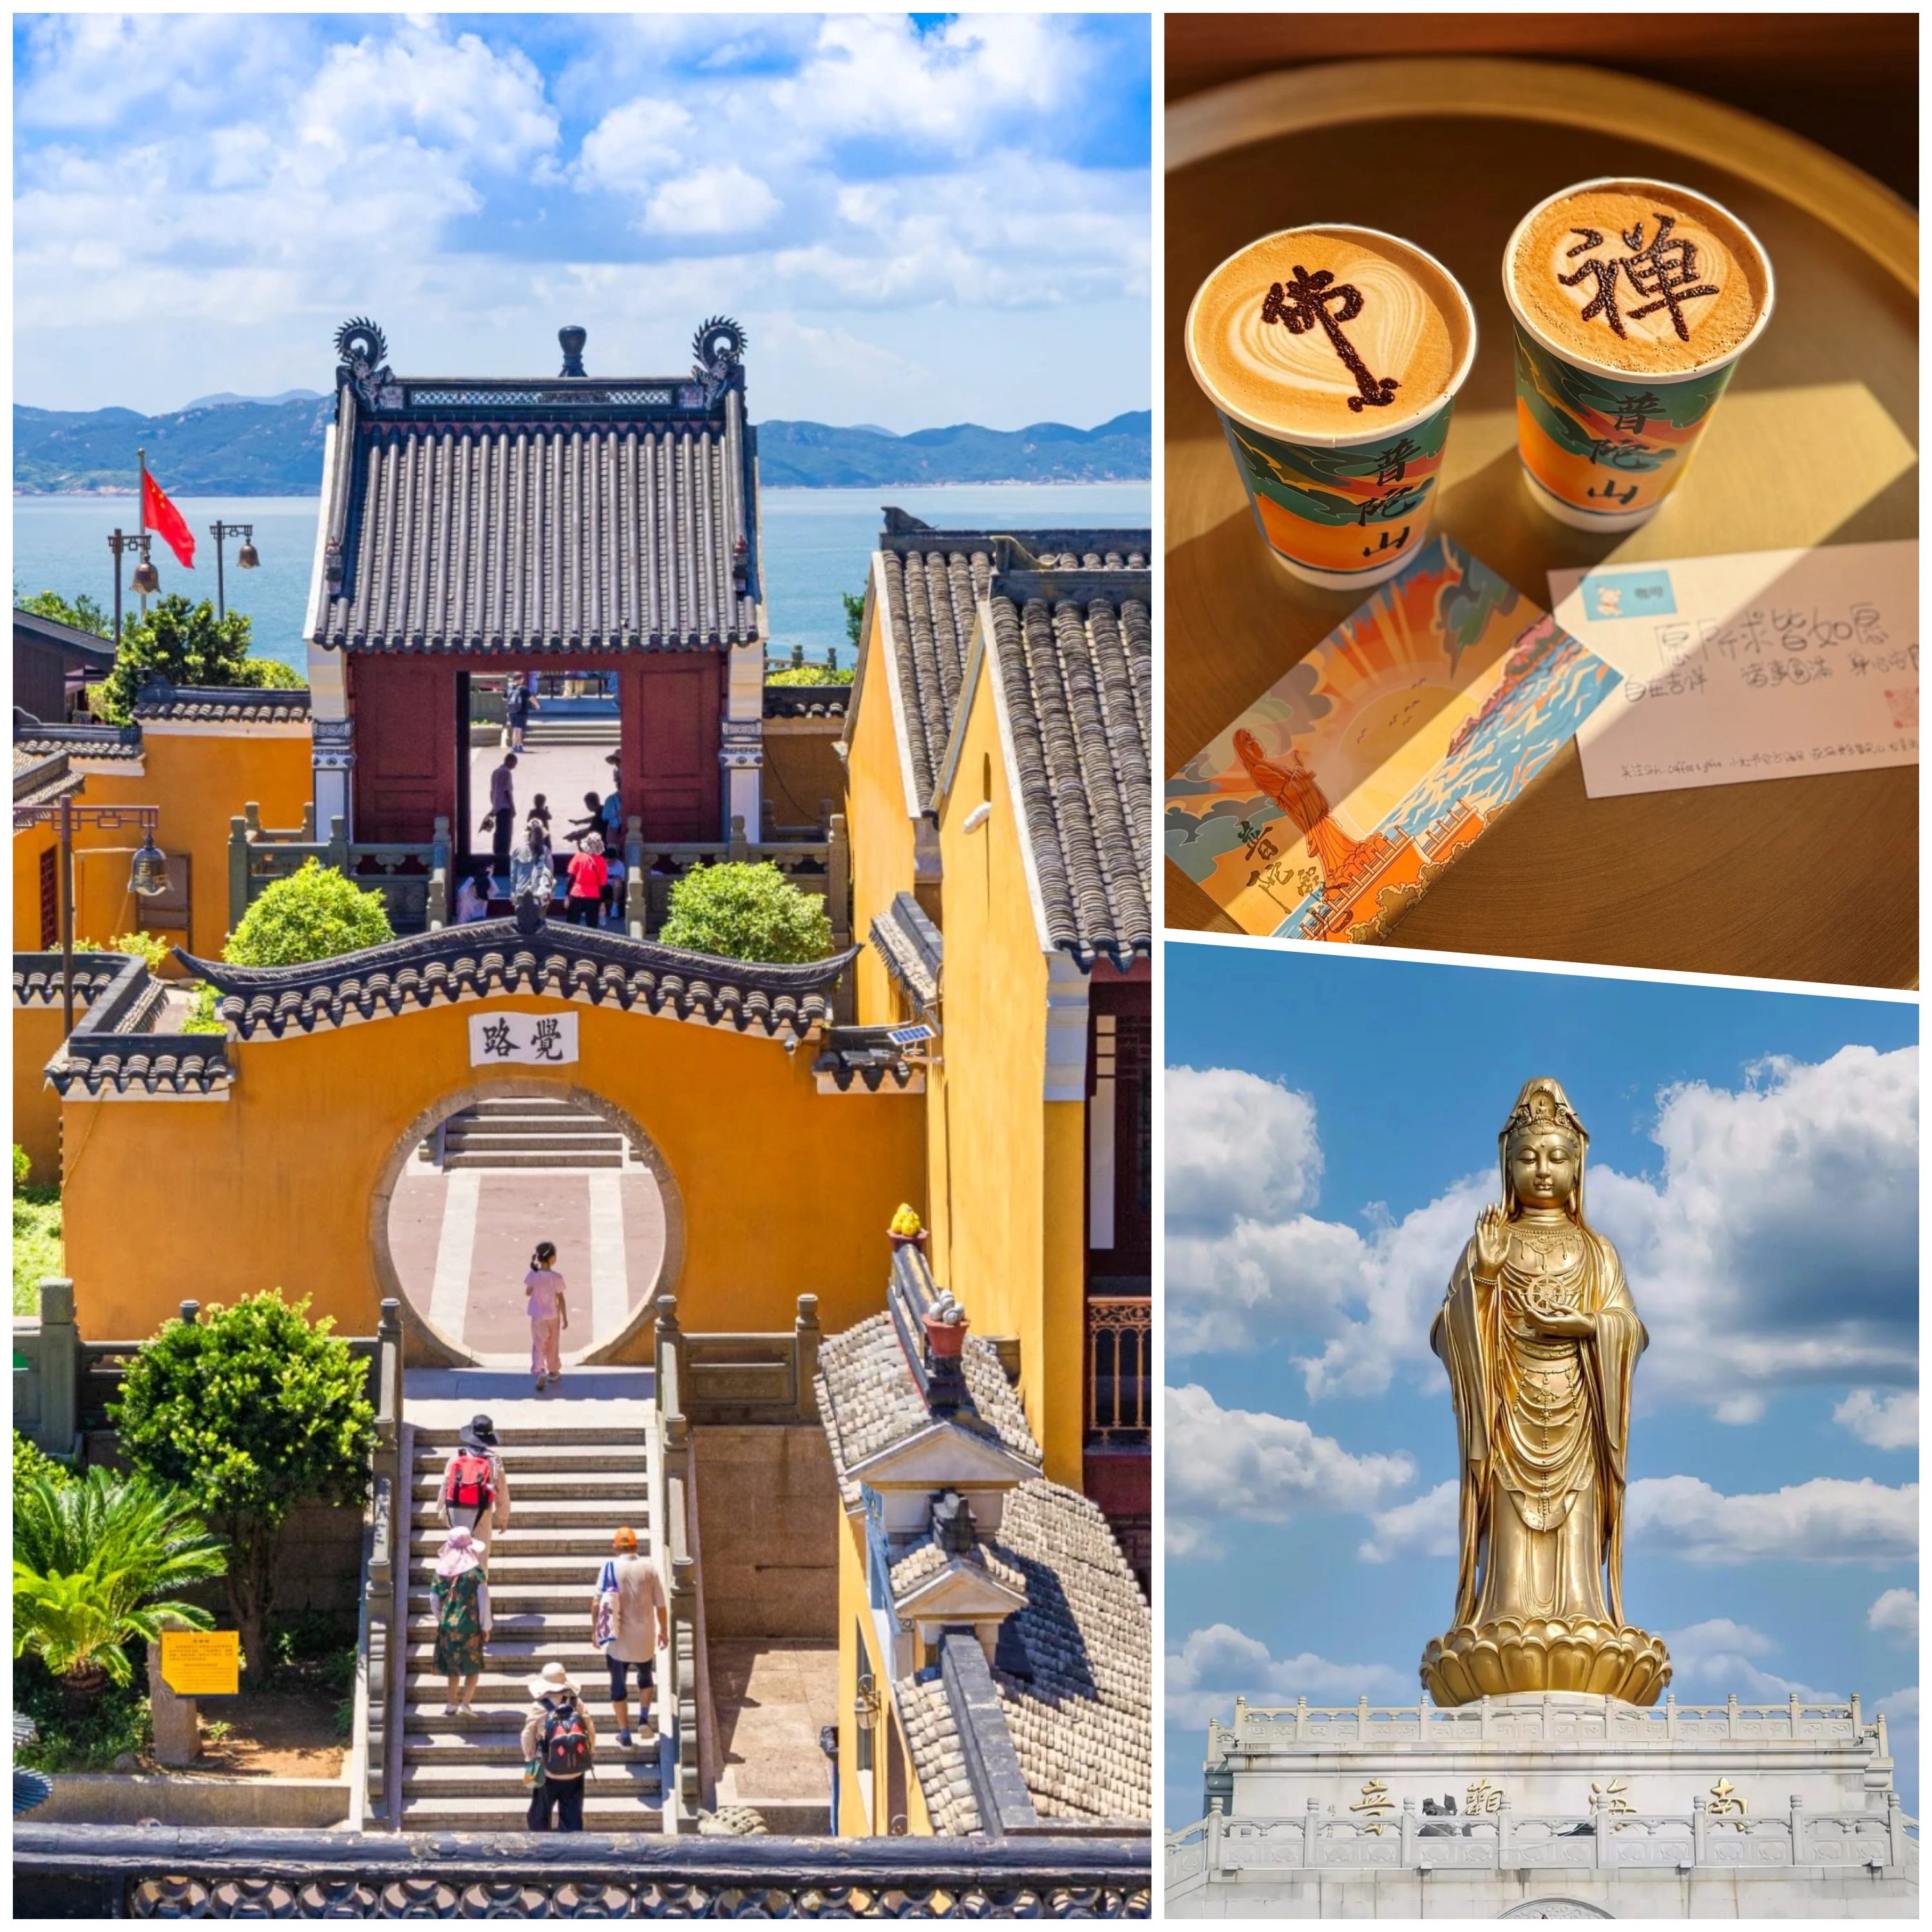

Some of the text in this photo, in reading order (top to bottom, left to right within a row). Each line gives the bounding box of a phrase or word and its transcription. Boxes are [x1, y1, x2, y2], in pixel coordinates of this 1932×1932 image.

[1557, 211, 1720, 343] 禅
[1356, 438, 1422, 558] 普陀山
[1587, 391, 1667, 505] 普陀山
[1653, 601, 1889, 667] 愿所求皆如愿
[482, 1017, 563, 1060] 覺路
